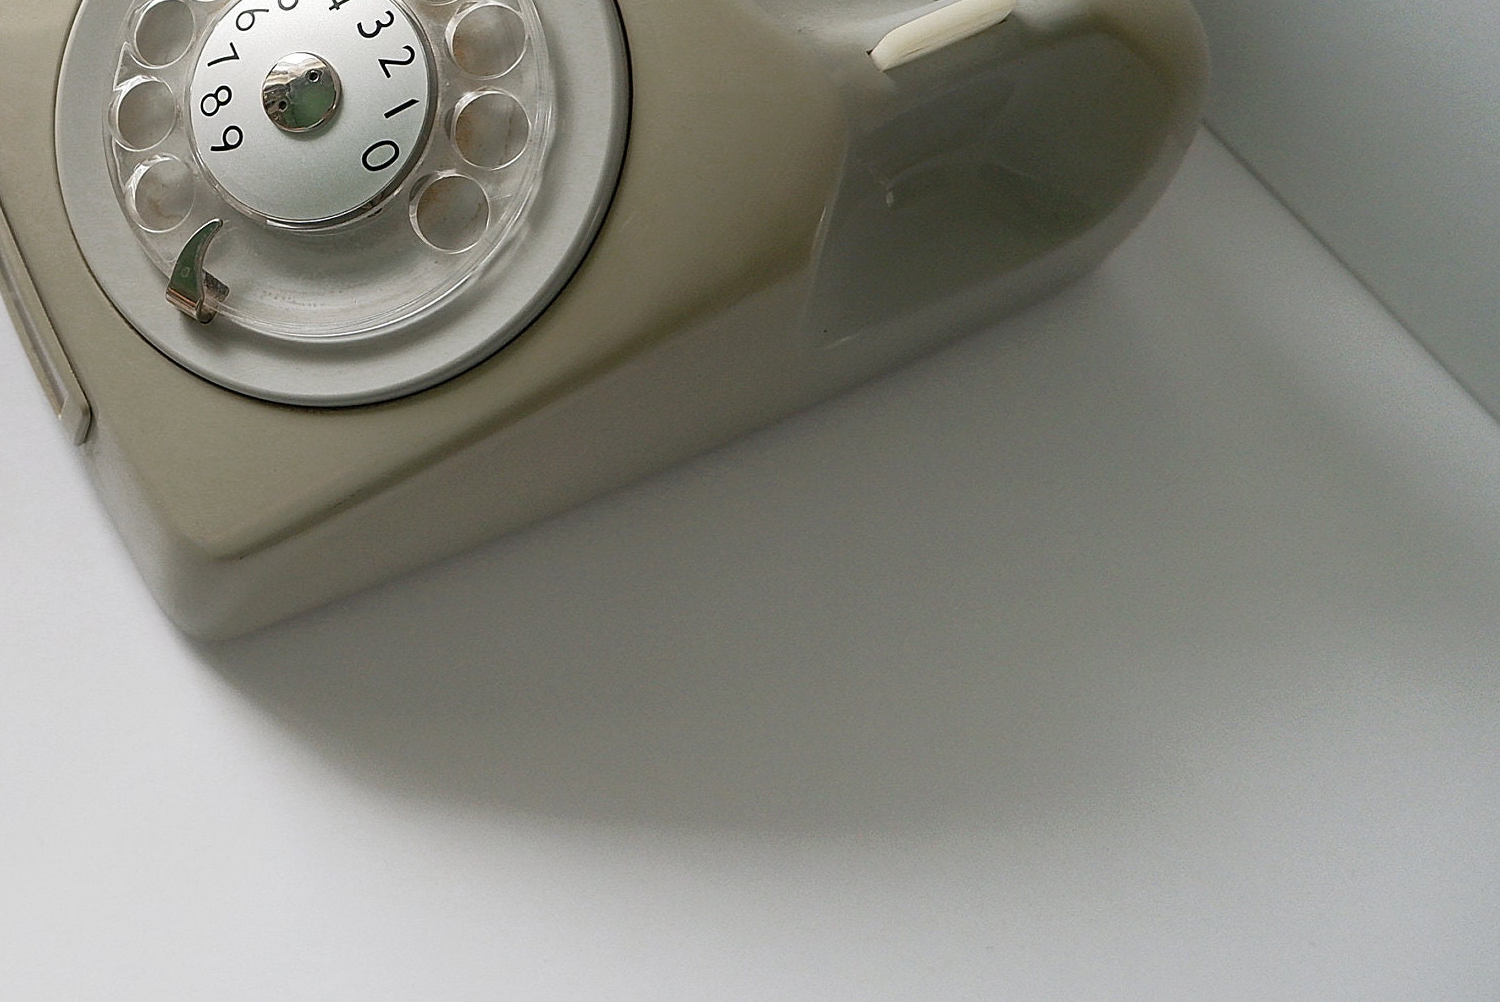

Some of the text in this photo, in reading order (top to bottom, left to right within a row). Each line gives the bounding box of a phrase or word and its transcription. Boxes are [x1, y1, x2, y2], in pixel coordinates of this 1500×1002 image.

[235, 8, 270, 31] 6
[356, 10, 395, 38] 3
[207, 42, 240, 67] 7
[378, 45, 415, 78] 2
[200, 85, 232, 117] 8
[384, 98, 420, 119] 1
[210, 125, 243, 151] 9
[361, 140, 400, 172] 0
